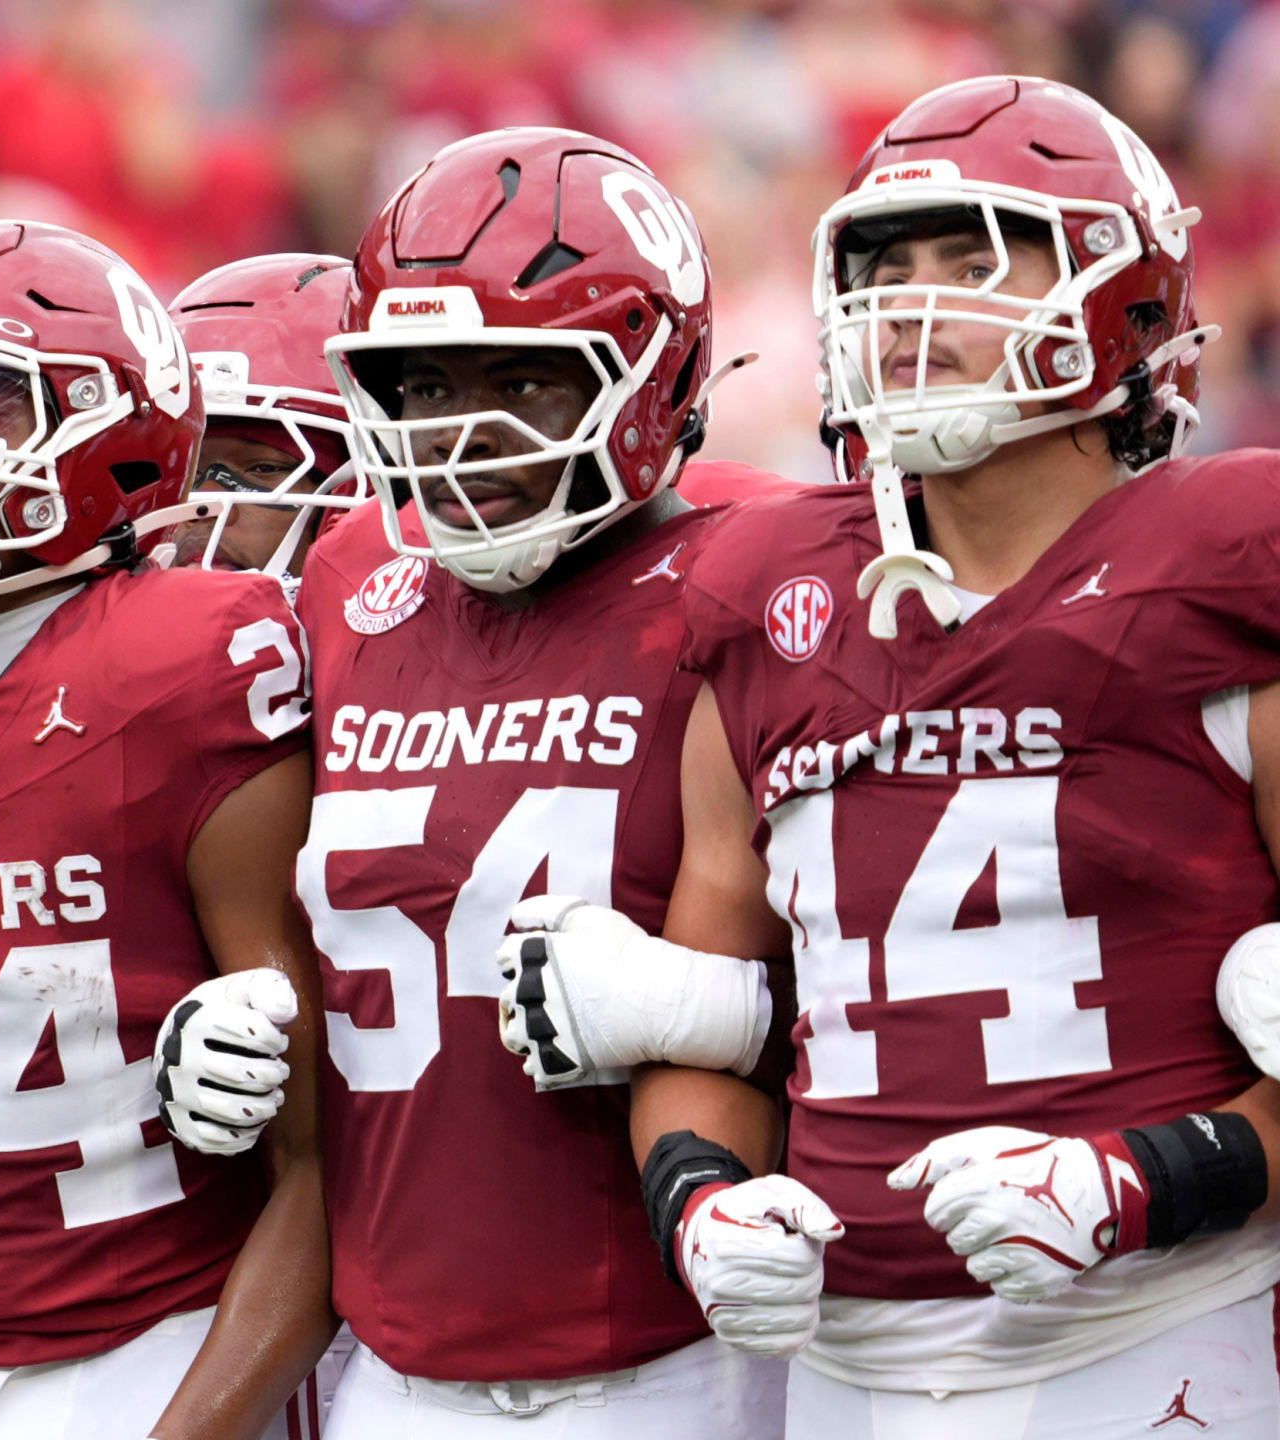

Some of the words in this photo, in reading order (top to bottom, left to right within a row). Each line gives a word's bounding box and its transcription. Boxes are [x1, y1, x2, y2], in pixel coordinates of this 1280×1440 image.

[387, 300, 446, 316] OKLAHOMA
[364, 556, 424, 611] SEC
[347, 609, 409, 632] GRADUATE
[768, 579, 830, 659] SEC
[325, 695, 643, 773] SOONERS
[295, 786, 632, 1093] 54
